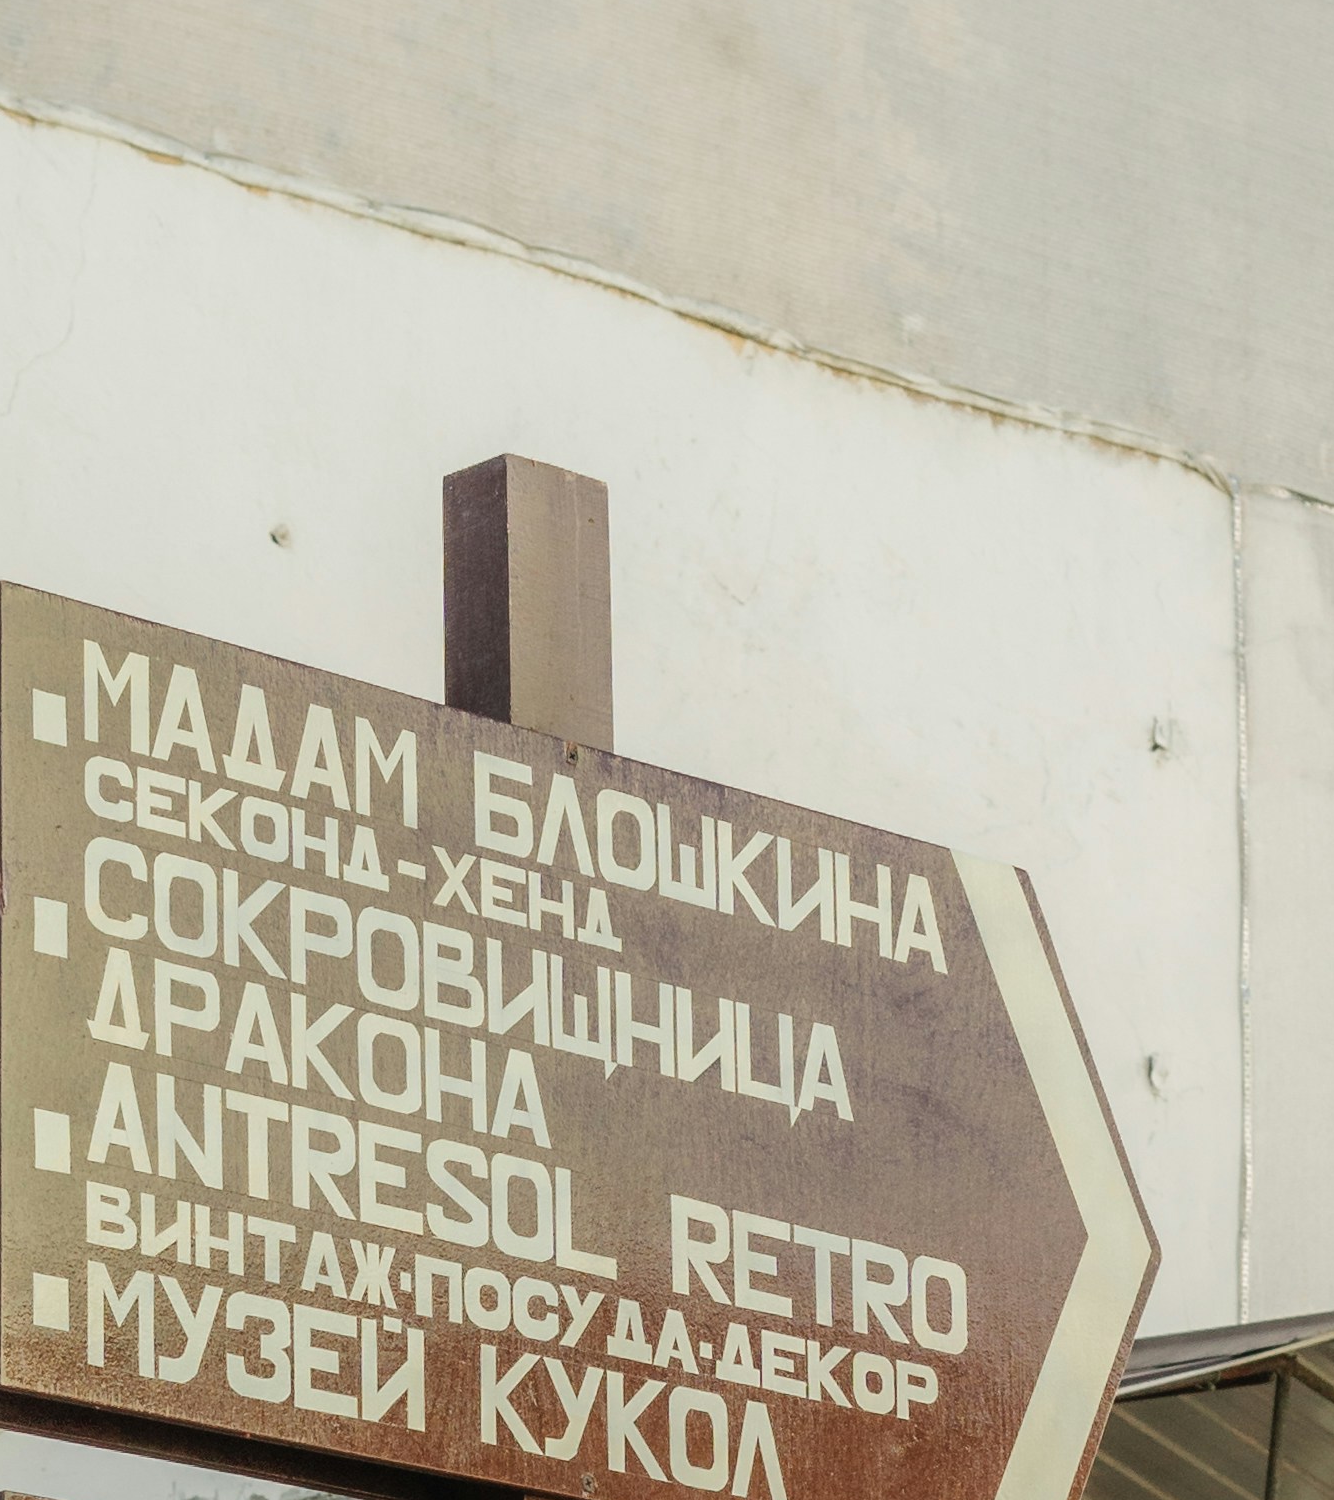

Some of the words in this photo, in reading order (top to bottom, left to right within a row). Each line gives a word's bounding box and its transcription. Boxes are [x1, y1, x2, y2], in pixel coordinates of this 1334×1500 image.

[83, 639, 418, 828] МАДАМ
[474, 750, 949, 975] БЛОШКИНА
[84, 760, 621, 952] СЕКОНД-ХЕНД
[83, 836, 854, 1127] СОКРОВИЩНИЦА
[85, 947, 551, 1149] ДРАКОНА
[85, 1063, 617, 1280] ANTRESOL
[670, 1194, 967, 1356] RETRO
[85, 1259, 426, 1432] МУЗЕЙ
